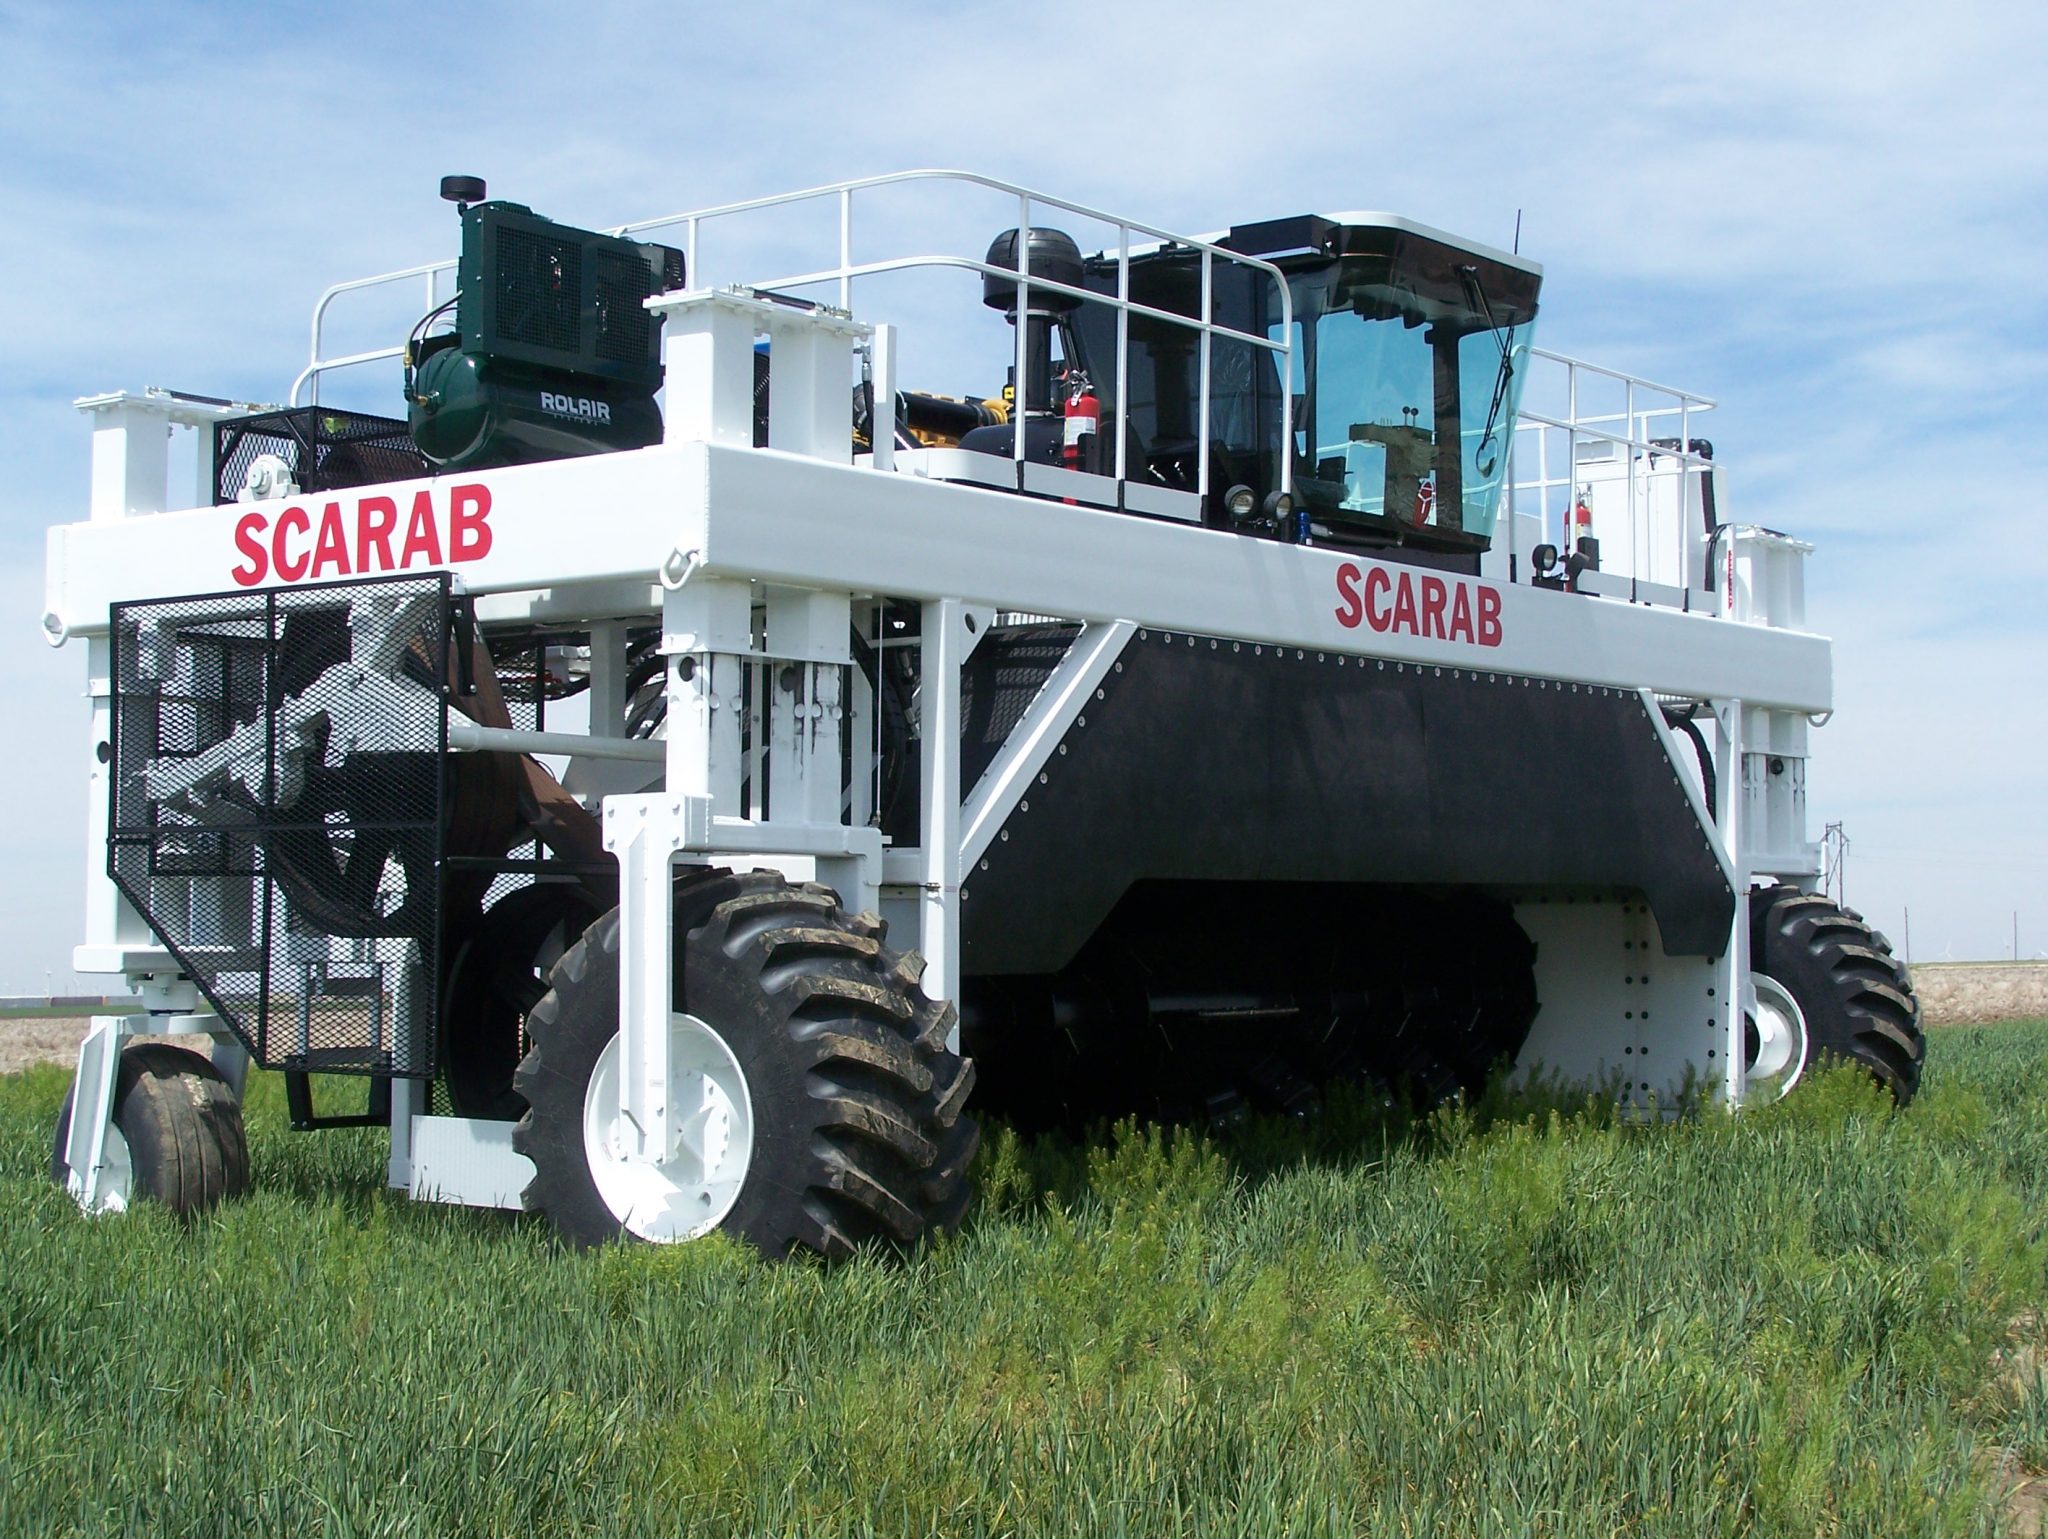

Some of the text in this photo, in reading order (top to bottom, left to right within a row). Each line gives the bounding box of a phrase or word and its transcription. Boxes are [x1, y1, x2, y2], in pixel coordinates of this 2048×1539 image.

[540, 391, 610, 420] ROLAIR
[231, 484, 493, 587] SCARAB
[1335, 562, 1503, 647] SCARAB
